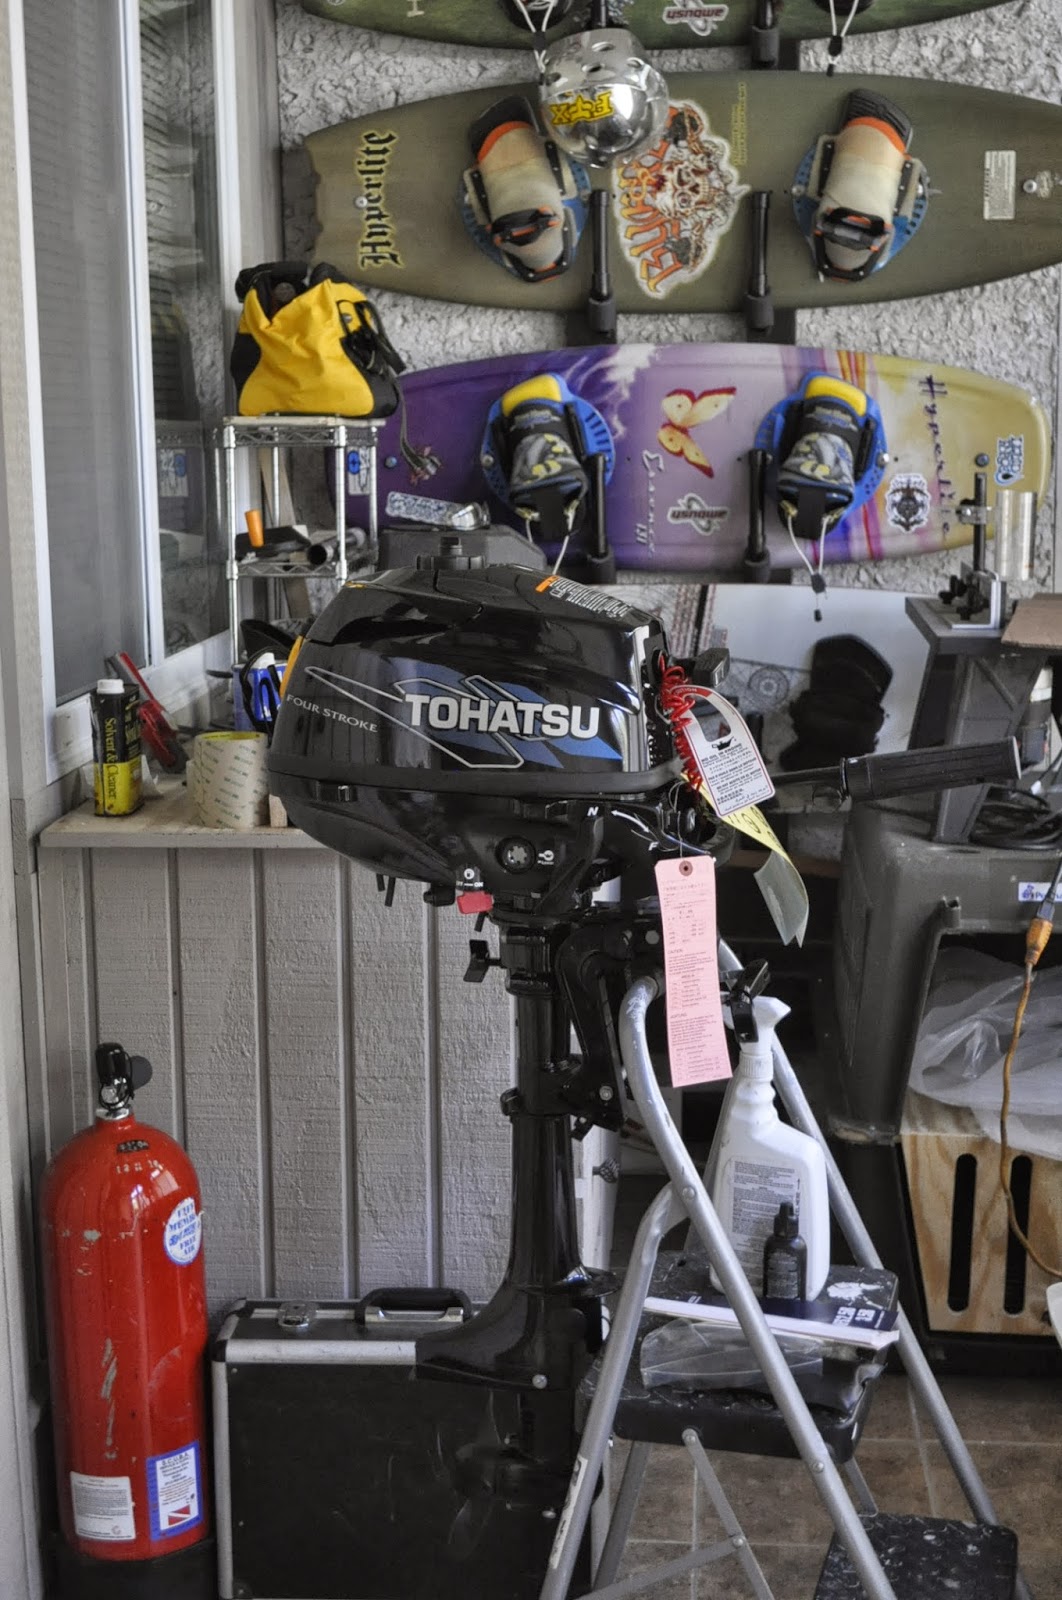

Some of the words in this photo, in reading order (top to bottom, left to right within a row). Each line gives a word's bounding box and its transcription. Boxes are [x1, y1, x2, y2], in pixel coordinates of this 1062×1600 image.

[357, 132, 400, 267] Hyperlite
[286, 694, 320, 715] FOUR
[322, 707, 378, 733] STROKE
[405, 693, 600, 739] TOHATSU
[587, 807, 599, 817] N
[648, 841, 659, 851] F
